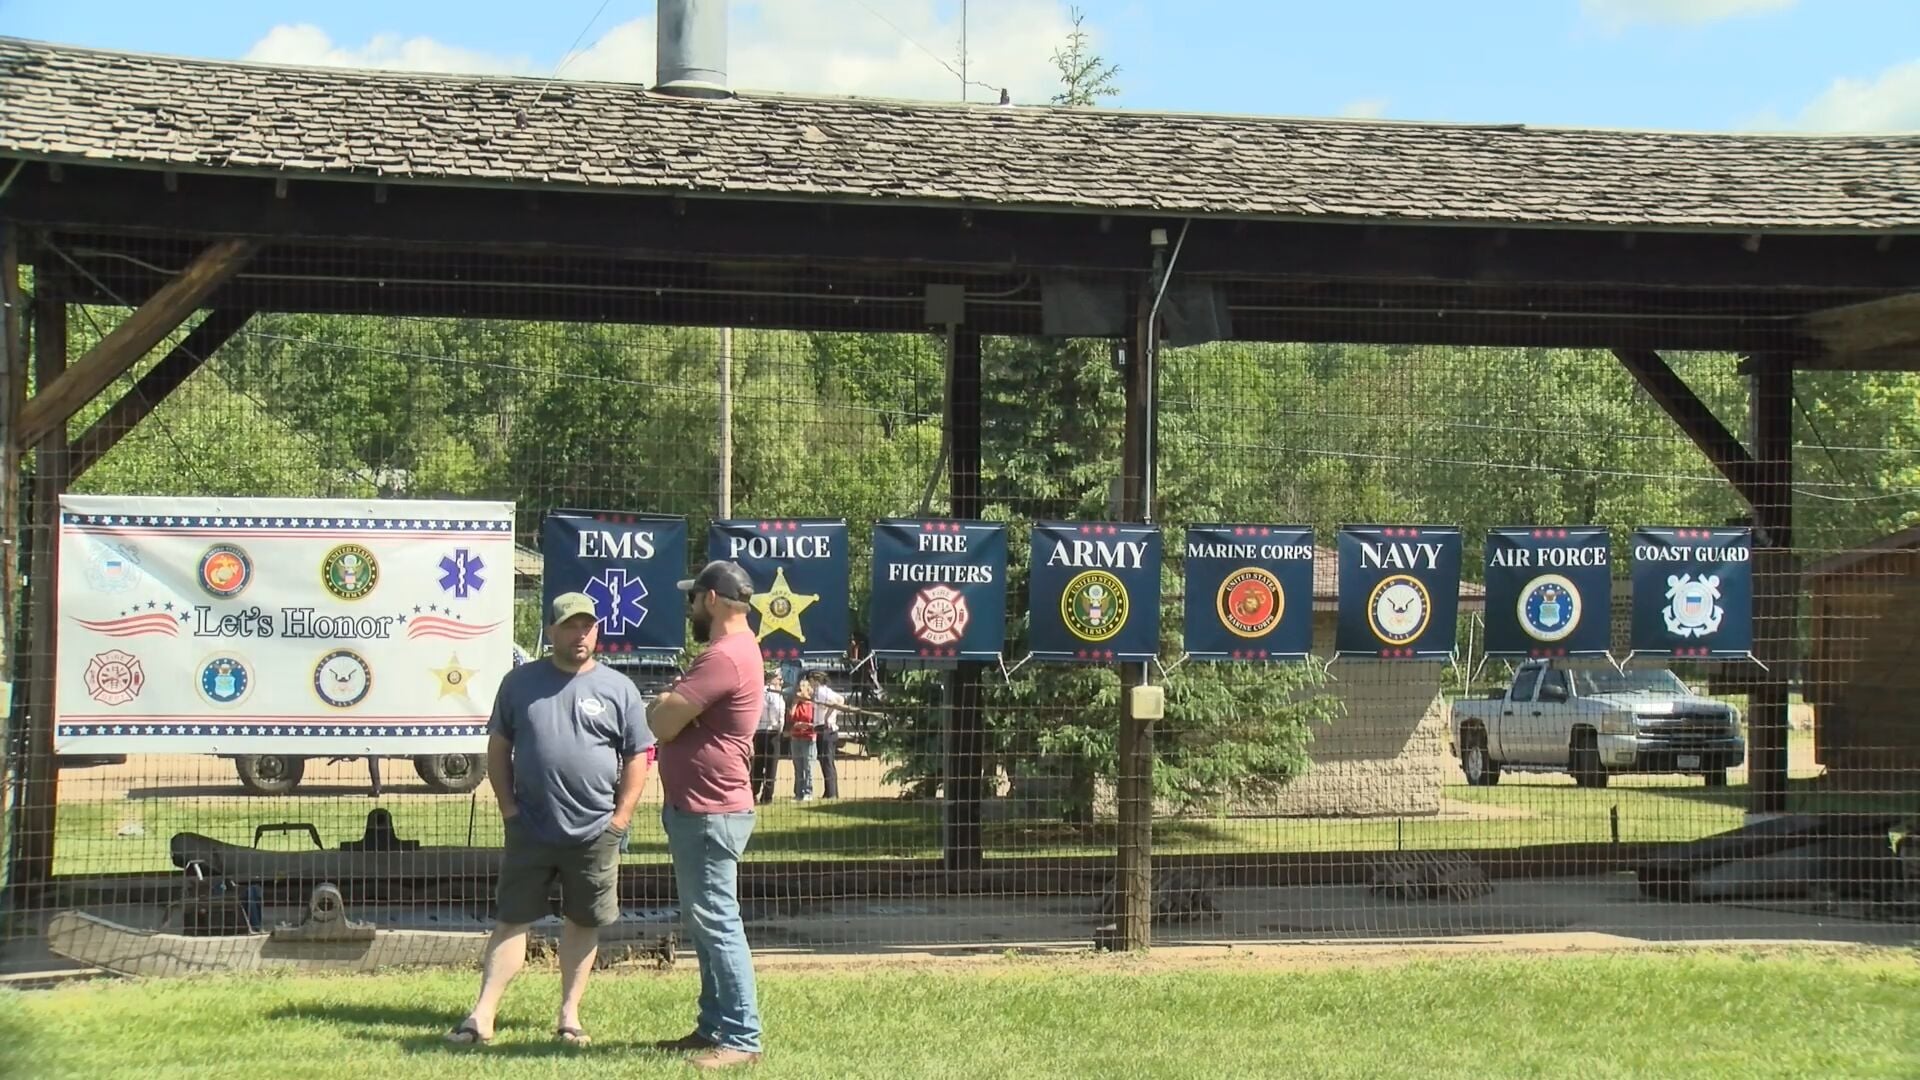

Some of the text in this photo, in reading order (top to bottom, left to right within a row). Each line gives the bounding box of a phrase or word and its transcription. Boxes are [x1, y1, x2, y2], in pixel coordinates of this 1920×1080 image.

[577, 531, 655, 560] EMS
[729, 535, 832, 559] POLICE
[918, 533, 968, 553] FIRE
[1188, 543, 1313, 561] MARINE CORPS
[1047, 540, 1149, 569] ARMY
[1359, 542, 1443, 570] NAVY
[1489, 547, 1607, 567] AIR FORCE
[1634, 545, 1750, 562] COAST GUARD
[888, 563, 993, 584] FIGHTERS
[1226, 573, 1276, 593] UNITED STATES
[193, 605, 393, 640] Let's Honor
[1226, 613, 1274, 632] MARINE CORPS
